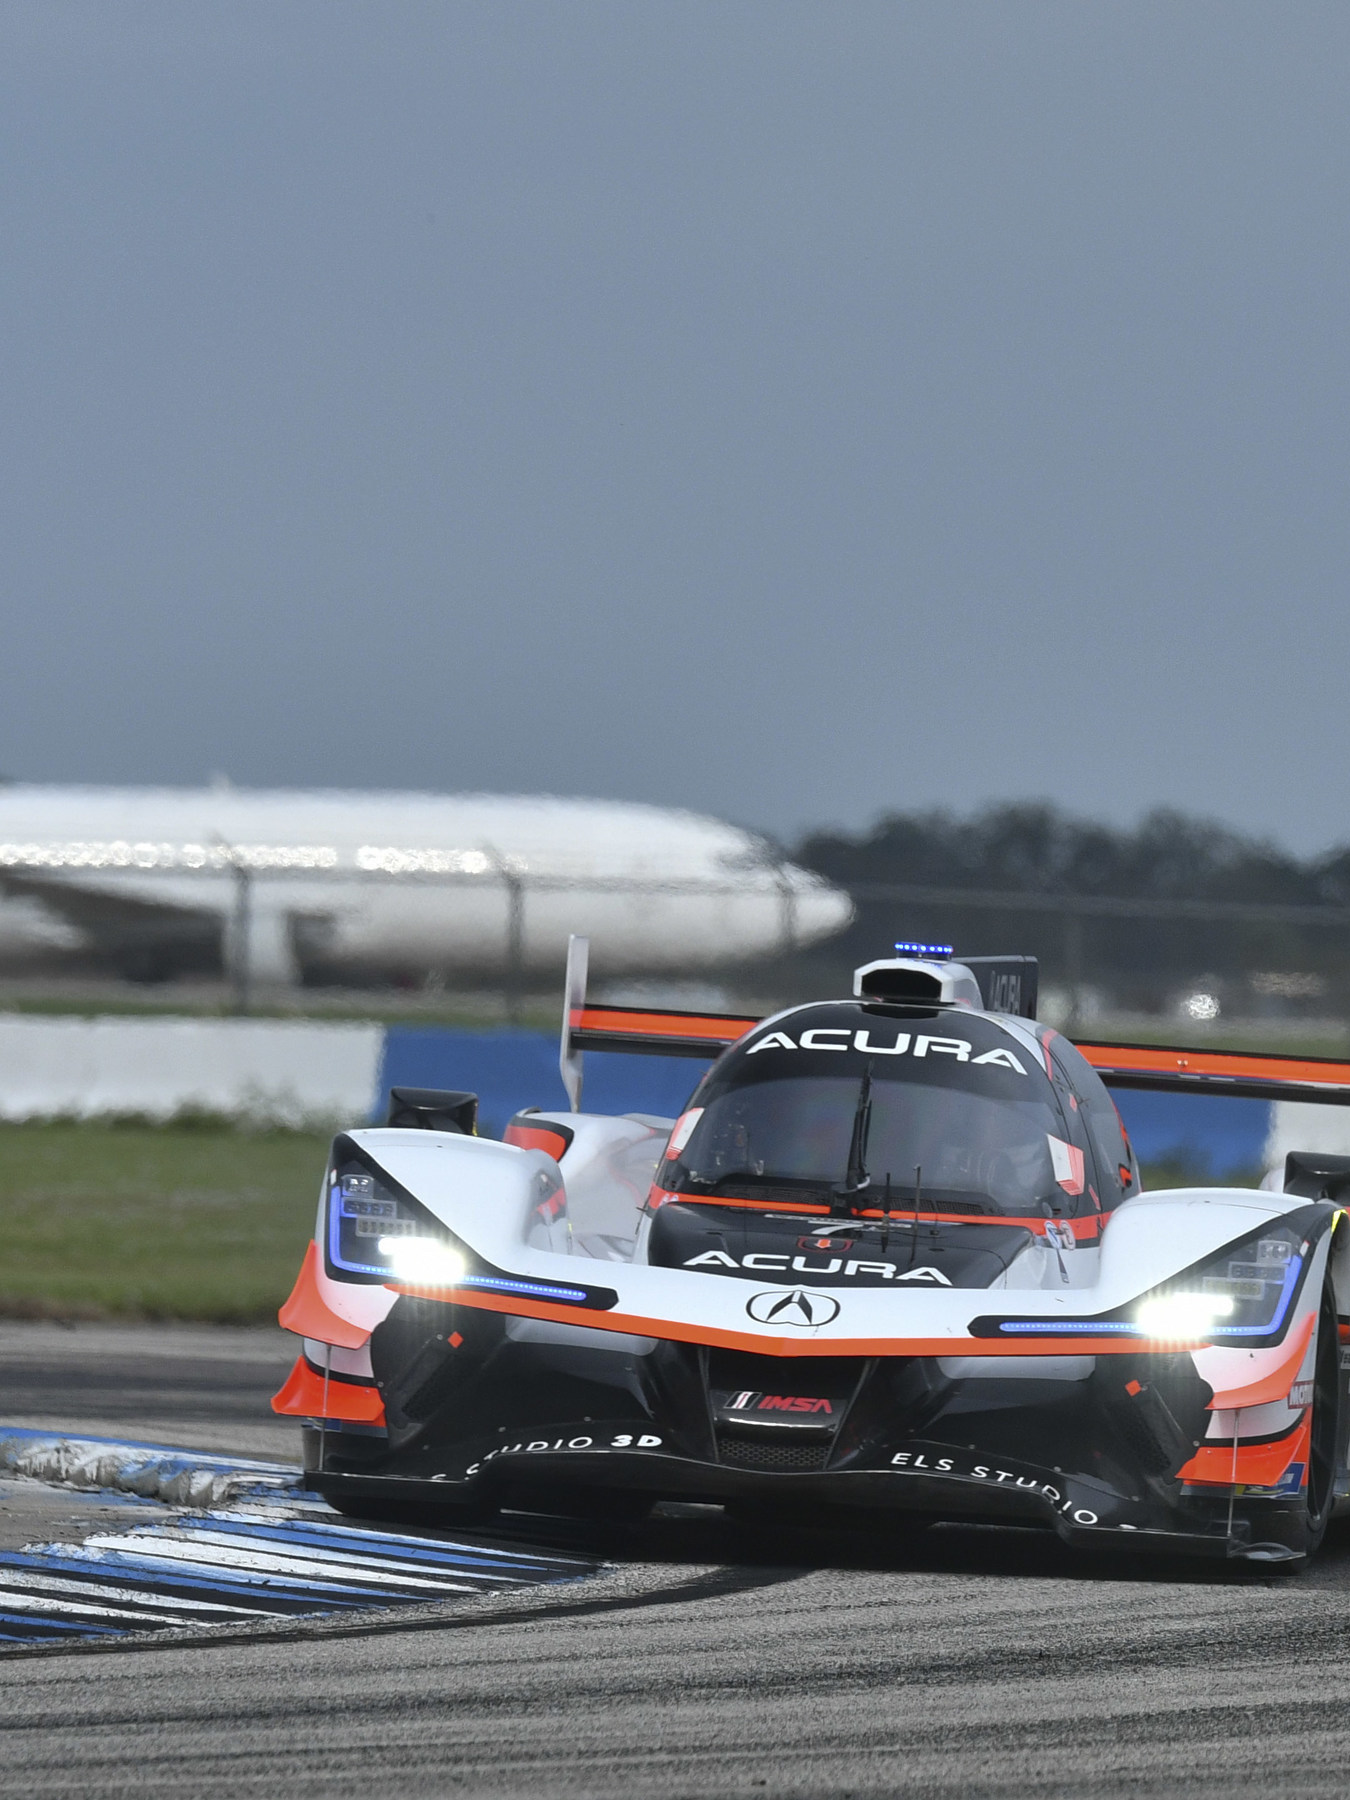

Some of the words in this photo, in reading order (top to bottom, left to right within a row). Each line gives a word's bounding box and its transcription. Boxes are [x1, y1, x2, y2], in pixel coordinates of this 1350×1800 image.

[745, 1028, 1029, 1075] ACURA
[682, 1250, 953, 1286] ACURA
[758, 1395, 833, 1414] IMSA
[610, 1433, 663, 1447] 3D
[890, 1452, 955, 1471] ELS
[970, 1465, 1099, 1525] STUDIO
